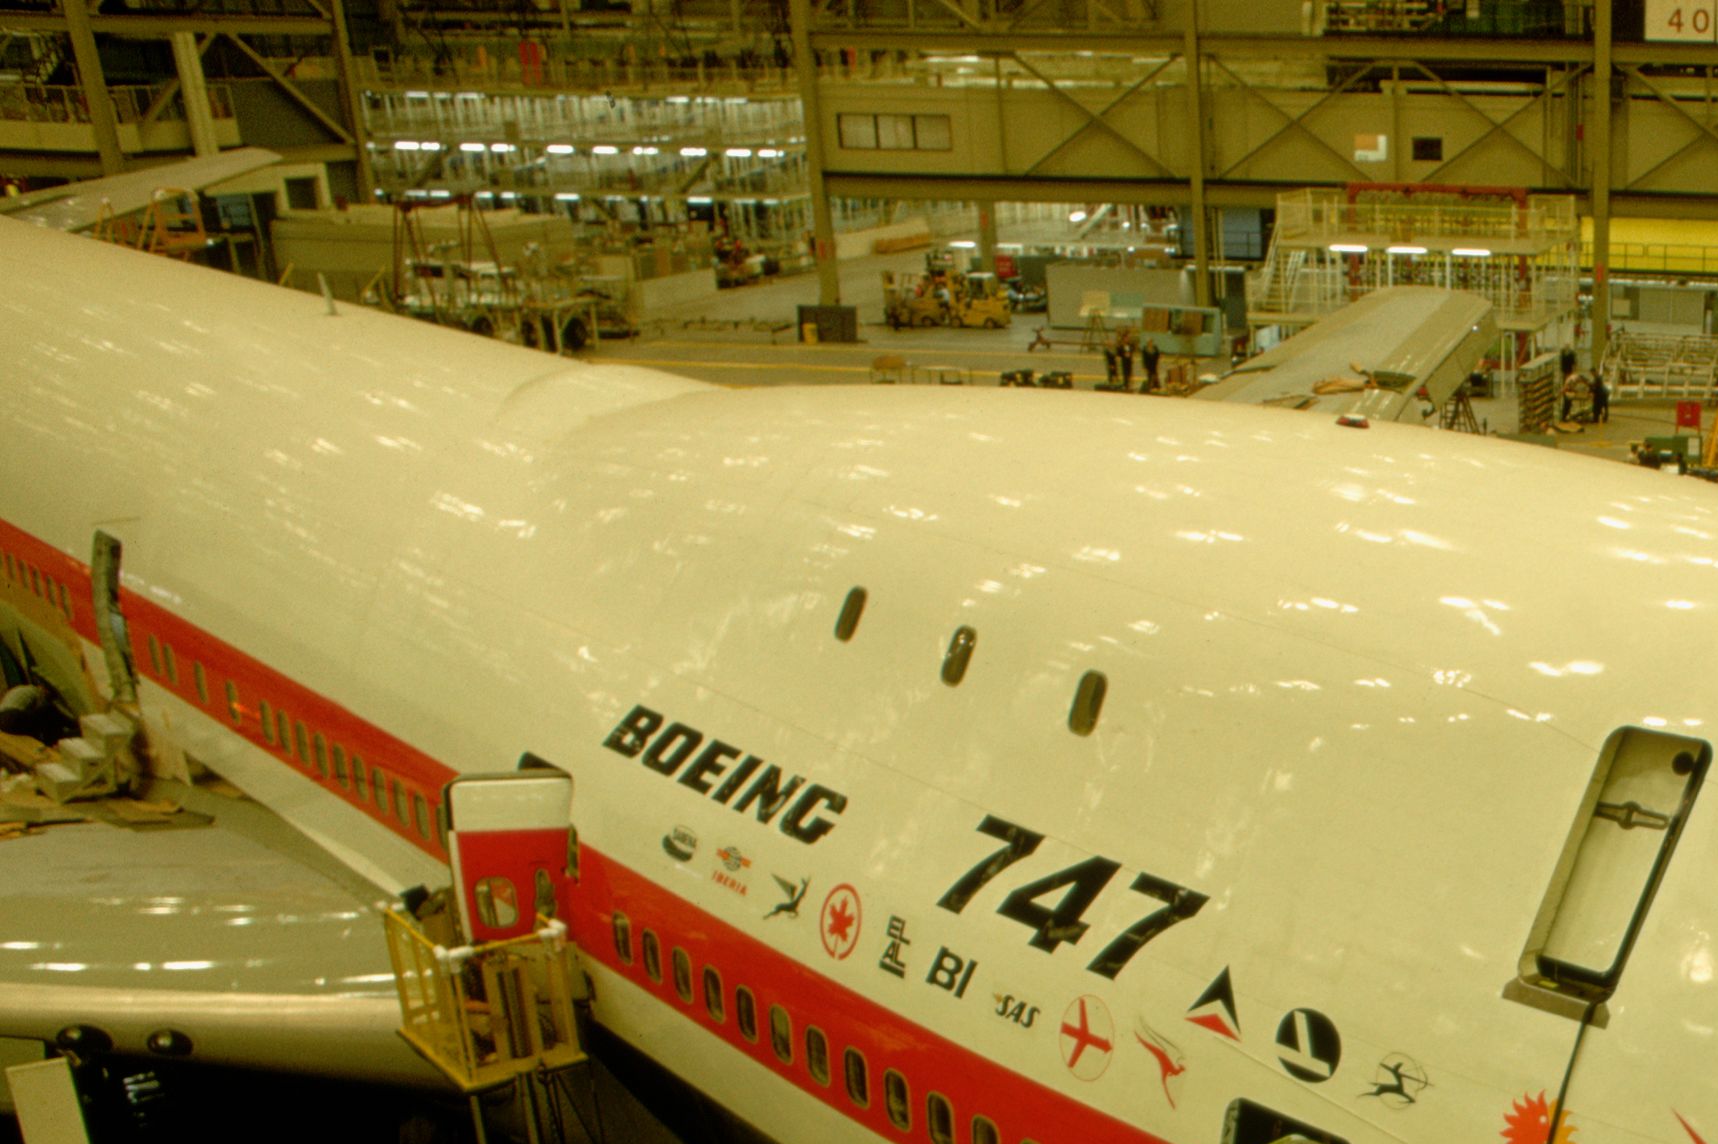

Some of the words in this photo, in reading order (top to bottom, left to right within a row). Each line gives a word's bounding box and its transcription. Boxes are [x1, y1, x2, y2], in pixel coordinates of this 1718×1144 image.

[602, 705, 848, 845] BOEING
[712, 871, 748, 896] IBERIA
[936, 813, 1211, 980] 747
[886, 915, 911, 945] EL
[882, 940, 907, 969] AL
[925, 946, 978, 999] BI
[995, 994, 1041, 1028] SAS
